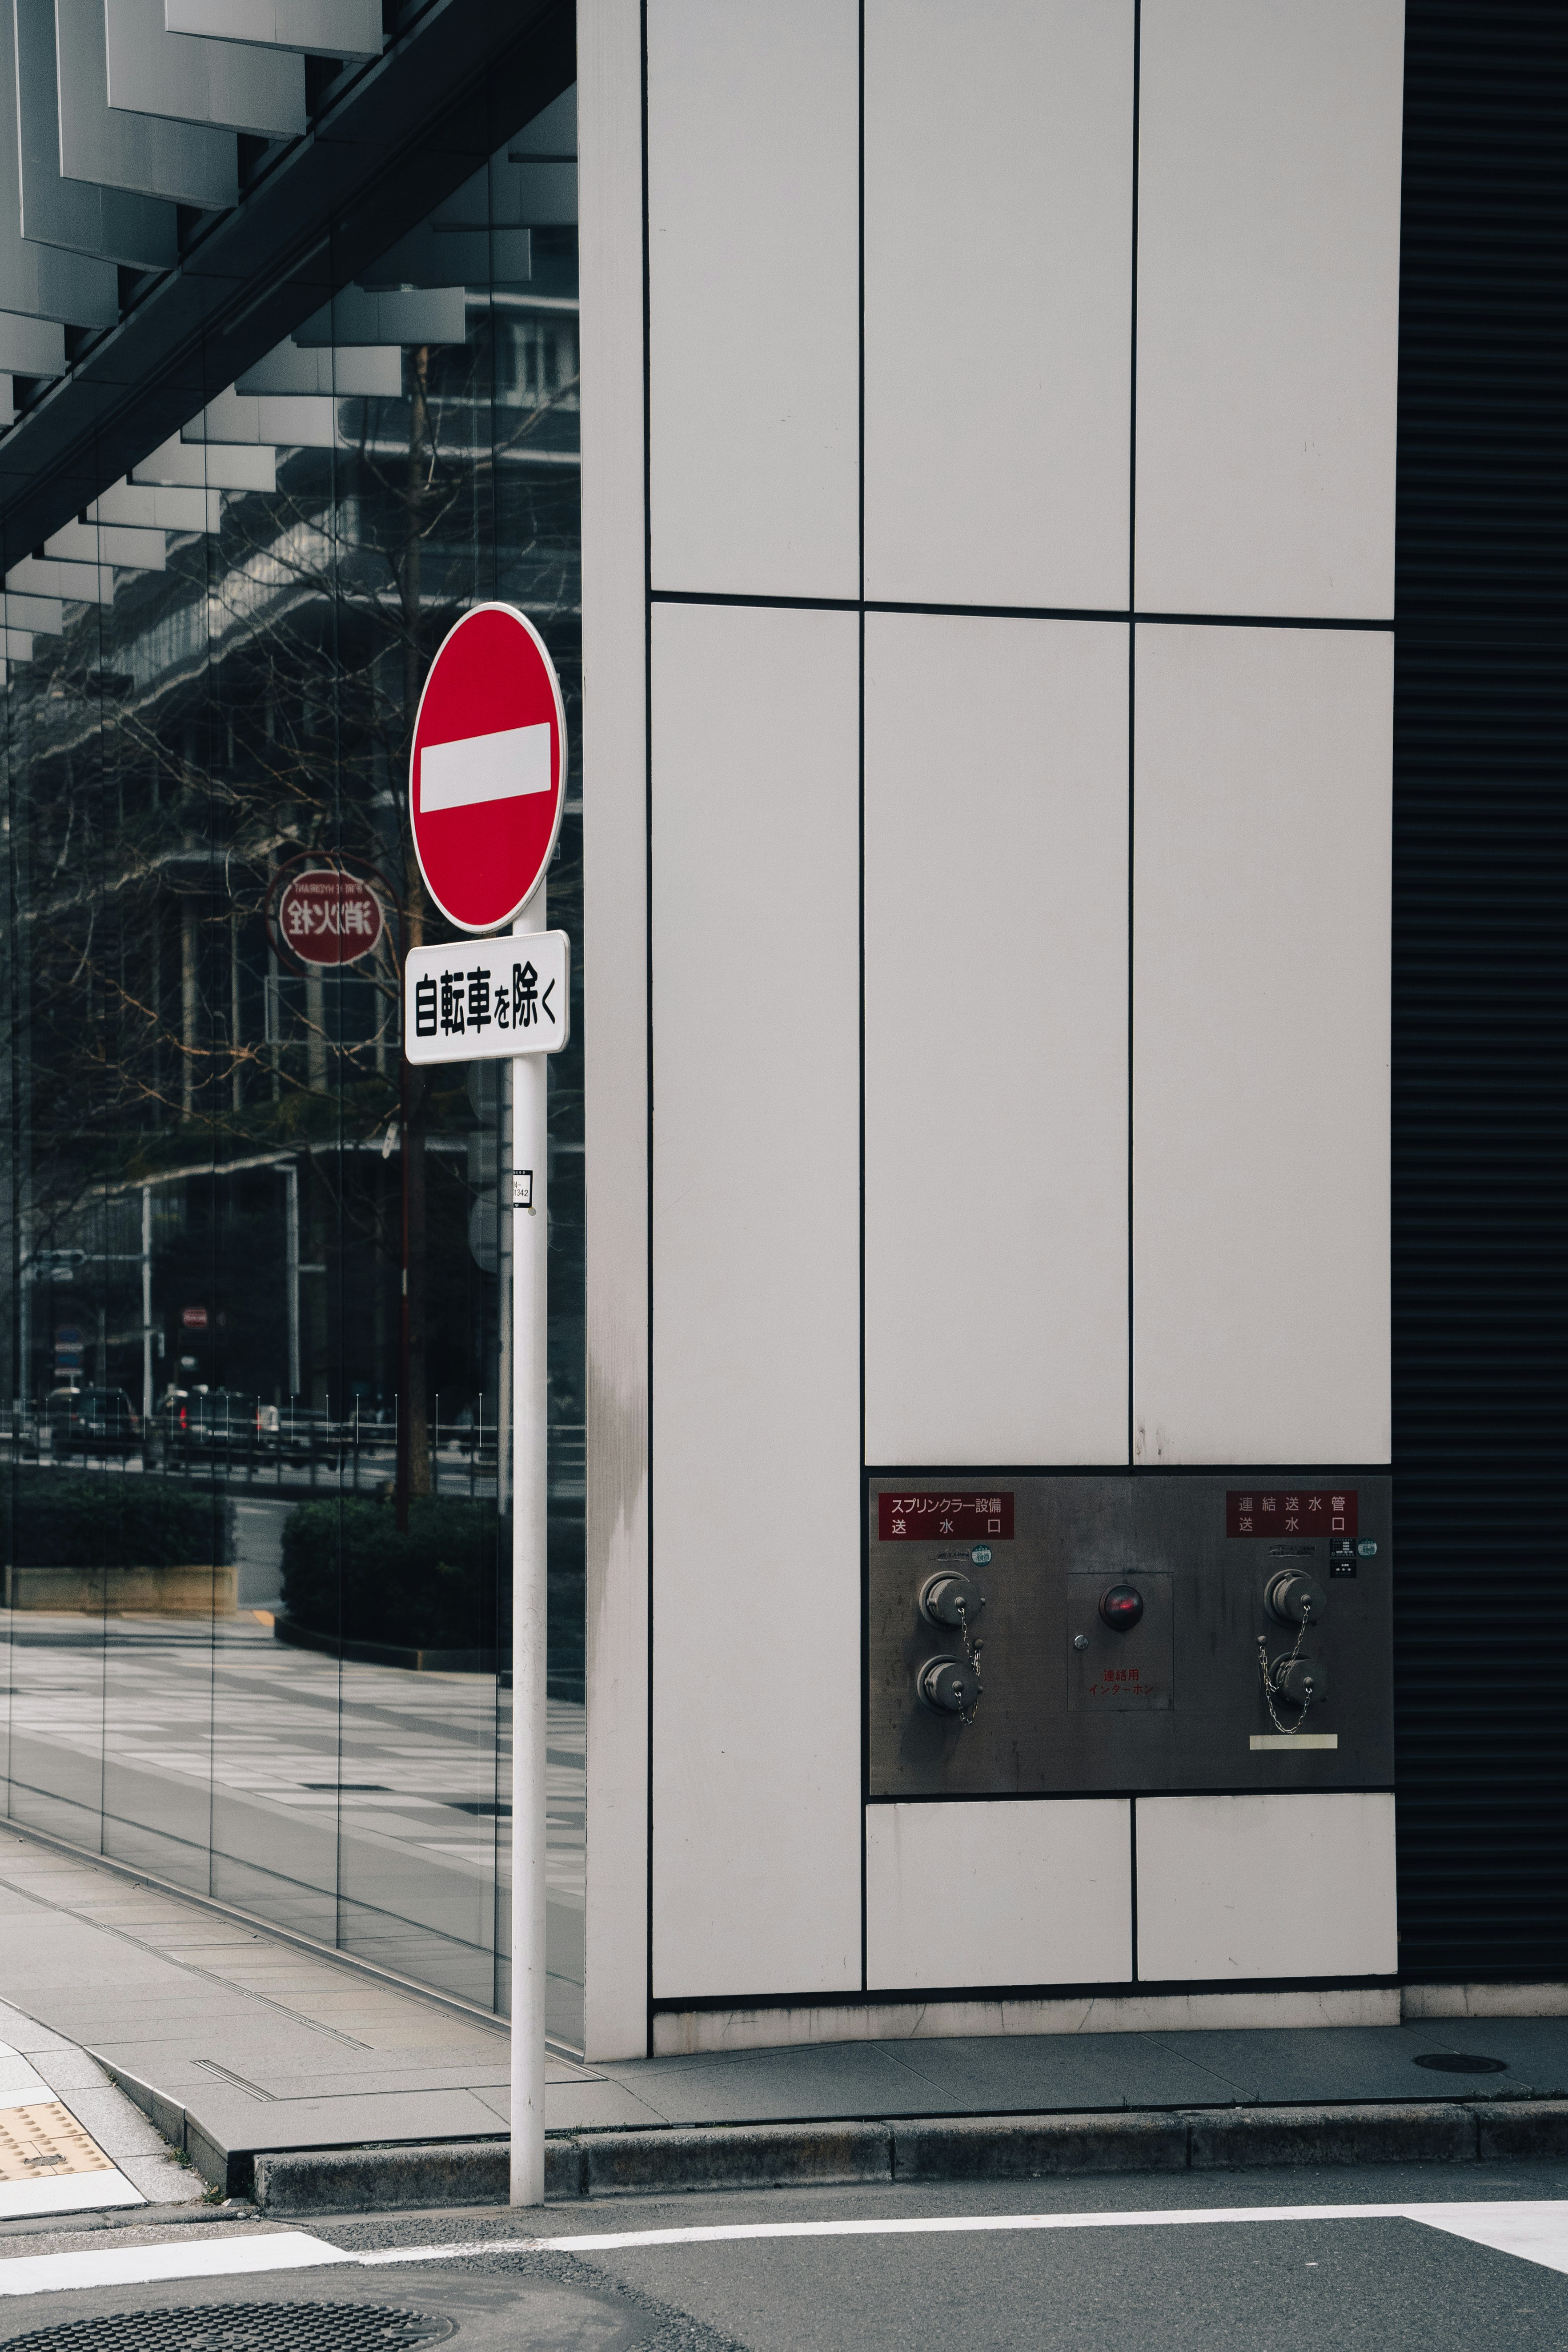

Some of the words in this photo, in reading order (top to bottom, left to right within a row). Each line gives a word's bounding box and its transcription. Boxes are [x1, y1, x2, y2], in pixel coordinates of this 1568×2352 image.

[416, 960, 556, 1037] 自転車を除く
[891, 1498, 1002, 1513] スプリンクラー設備
[1239, 1496, 1346, 1512] 連結送水管
[892, 1518, 1001, 1534] 送水口
[1239, 1517, 1345, 1532] 送水口
[1103, 1669, 1139, 1682] 連絡用
[1089, 1684, 1154, 1696] インターホン
